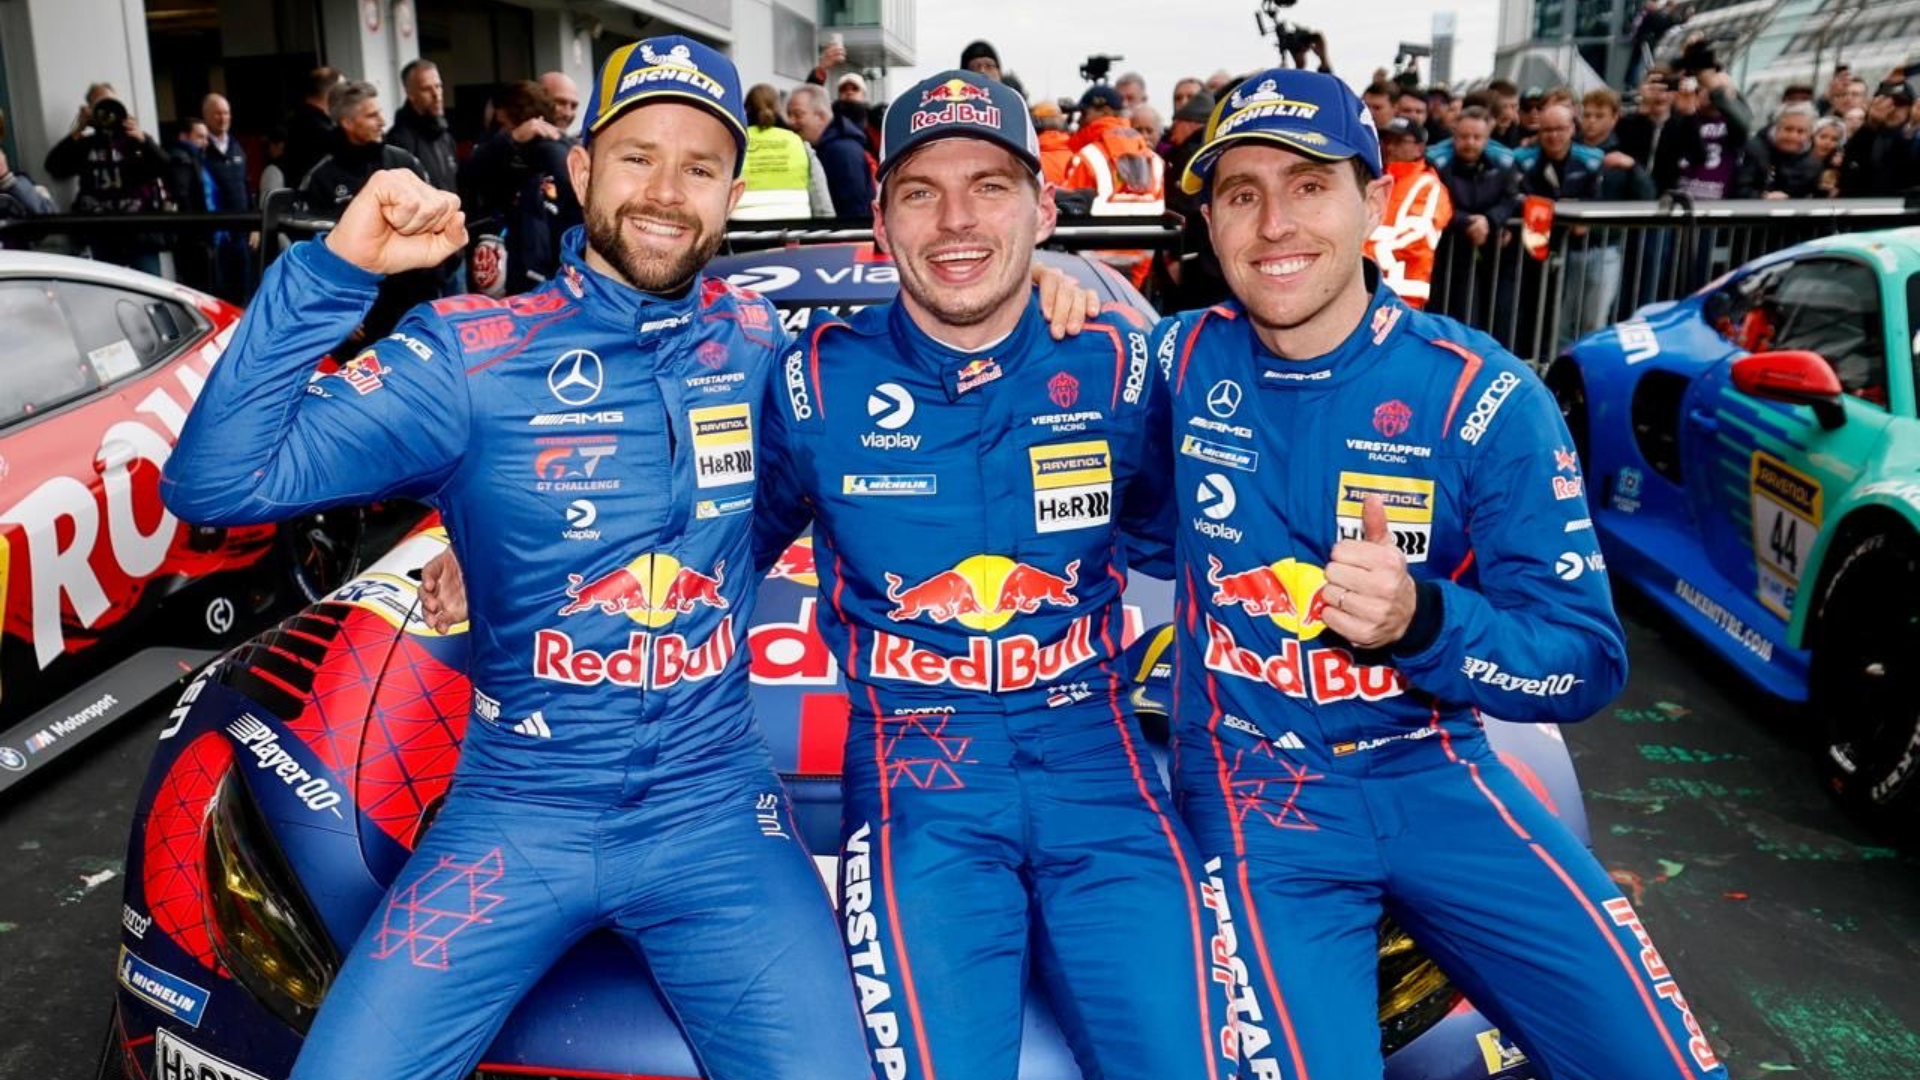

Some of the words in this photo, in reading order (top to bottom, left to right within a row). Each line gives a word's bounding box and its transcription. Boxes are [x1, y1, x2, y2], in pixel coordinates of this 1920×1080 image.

[618, 68, 726, 100] MICHELIN
[911, 103, 955, 134] Red
[957, 103, 1002, 130] Bull
[1215, 104, 1318, 138] MICHELIN
[460, 320, 515, 346] OMP
[686, 372, 745, 387] VERSTAPPEN
[1122, 332, 1148, 404] sparco
[703, 384, 732, 393] RACING
[786, 350, 813, 421] sparco
[560, 411, 624, 425] AMG
[1031, 411, 1103, 426] VERSTAPPEN
[1460, 371, 1522, 446] sparco
[700, 420, 745, 432] RAVENOL
[1052, 422, 1086, 432] RACING
[1210, 422, 1252, 439] AMG
[860, 431, 922, 451] viaplay
[1202, 446, 1250, 465] MICHELIN
[1346, 439, 1431, 458] VERSTAPPEN
[700, 453, 734, 476] H&R
[1041, 458, 1103, 472] RAVENOL
[1369, 452, 1407, 464] RACING
[537, 481, 552, 491] GT
[554, 480, 620, 491] CHALLENGE
[868, 480, 928, 490] MICHELIN
[1040, 497, 1085, 521] H&R
[562, 529, 600, 540] viaplay
[1193, 517, 1243, 544] viaplay
[1770, 511, 1798, 574] 44
[1675, 578, 1774, 662] FALKENTYRE.COM
[533, 629, 651, 691] Red
[651, 614, 737, 691] Bull
[870, 630, 993, 694] Red
[997, 614, 1097, 692] Bull
[1204, 612, 1308, 698] Red
[1307, 648, 1405, 705] Bu
[1462, 656, 1546, 696] Player
[50, 693, 118, 738] Motorsport
[241, 716, 312, 786] Player
[756, 793, 790, 840] JULES
[844, 821, 907, 1080] VERSTAPP
[1601, 896, 1671, 981] Bull
[131, 971, 196, 1013] MICHELIN
[1654, 979, 1719, 1073] Red
